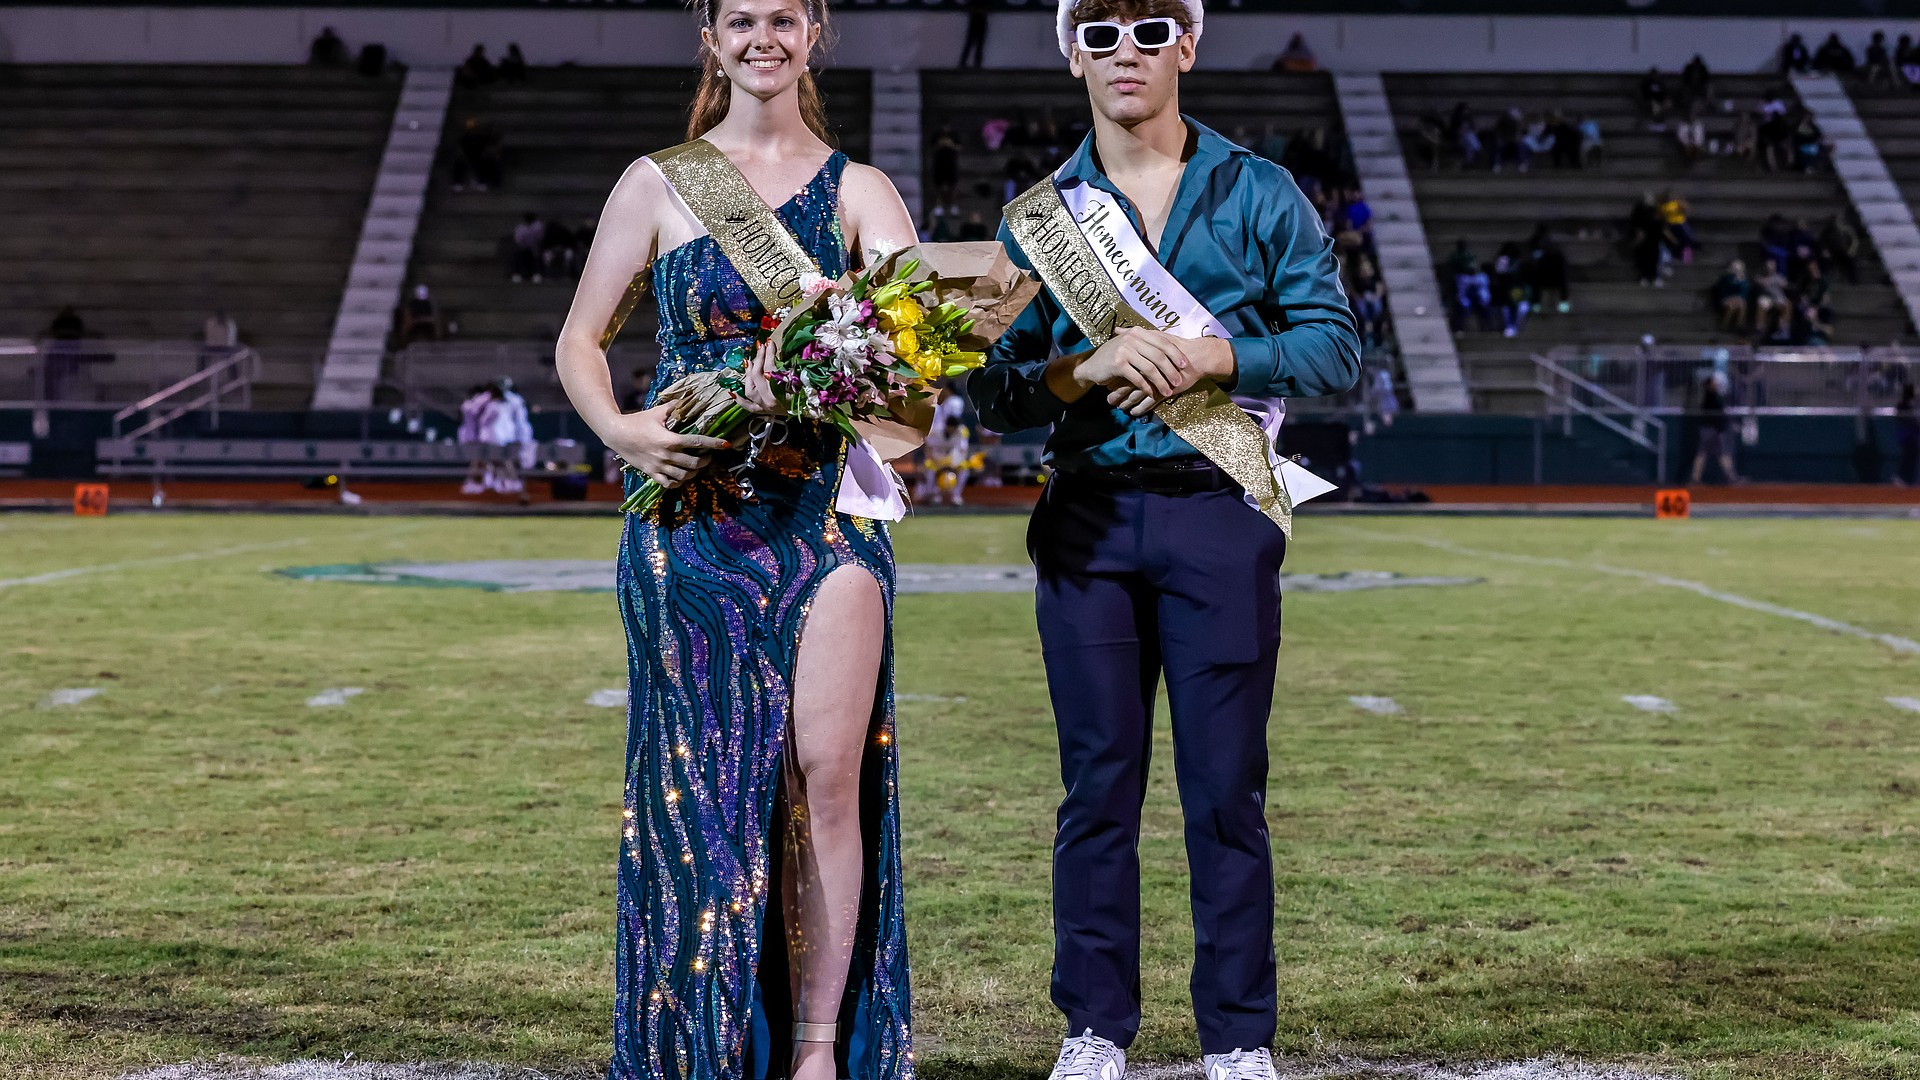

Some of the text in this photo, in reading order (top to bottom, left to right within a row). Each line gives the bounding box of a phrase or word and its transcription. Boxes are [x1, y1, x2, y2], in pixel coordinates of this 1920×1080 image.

[1031, 213, 1134, 340] HOMECOMIN
[1076, 199, 1181, 331] Homecoming
[78, 489, 104, 512] 40
[1659, 495, 1686, 516] 40
